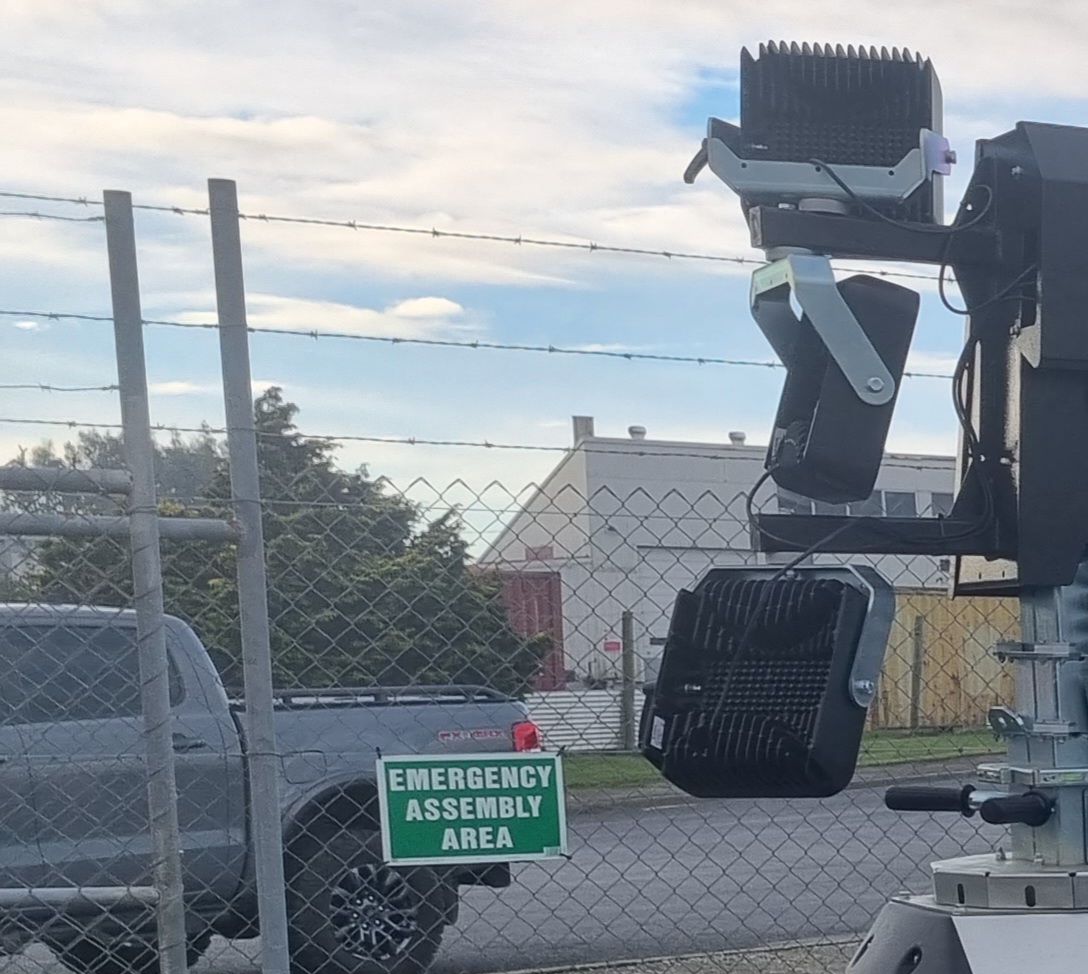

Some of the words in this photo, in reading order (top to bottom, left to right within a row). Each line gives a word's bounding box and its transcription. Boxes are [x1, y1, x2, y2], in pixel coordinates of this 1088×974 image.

[388, 765, 552, 791] EMERGENCY
[405, 795, 542, 822] ASSEMBLY
[441, 826, 513, 850] AREA
